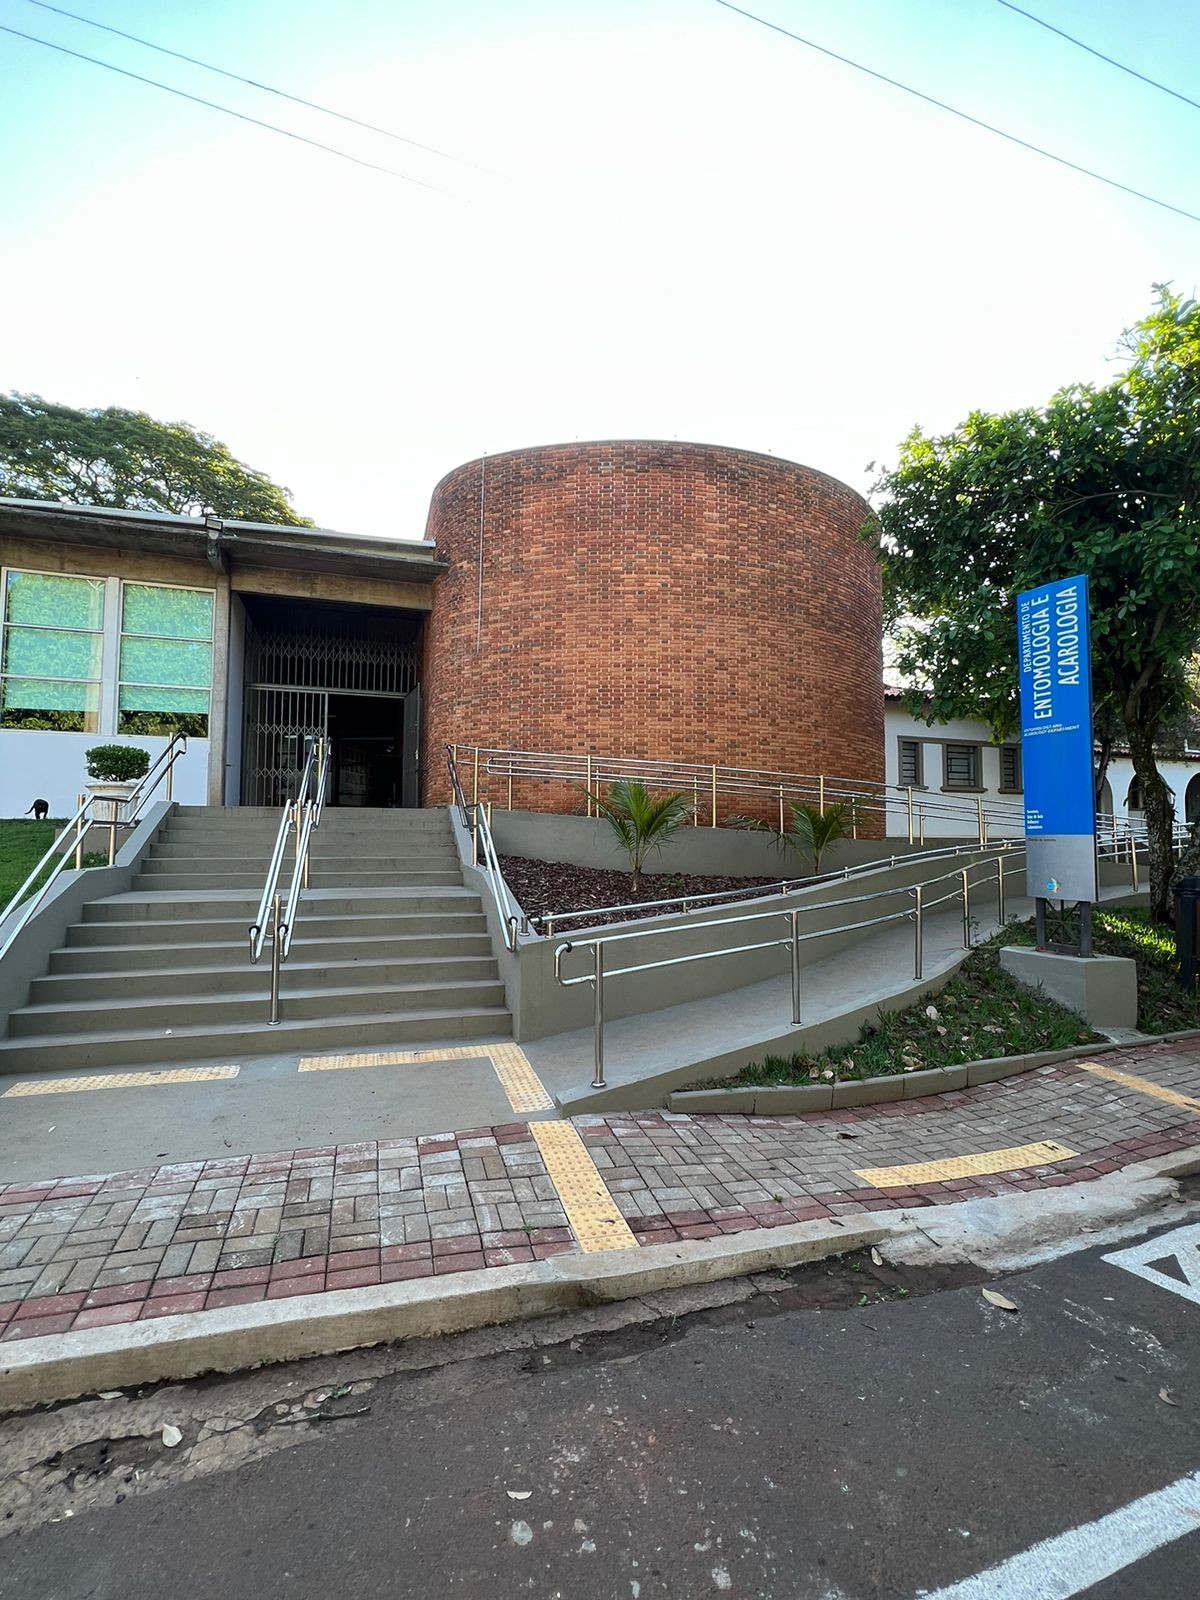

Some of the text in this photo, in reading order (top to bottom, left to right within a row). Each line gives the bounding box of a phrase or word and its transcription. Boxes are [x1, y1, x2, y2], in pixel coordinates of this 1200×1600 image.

[1021, 601, 1032, 673] DEPARTAMENTO DE
[1031, 593, 1052, 720] ENTOMOLOGIA E
[1056, 586, 1079, 685] ACAROLOGIA
